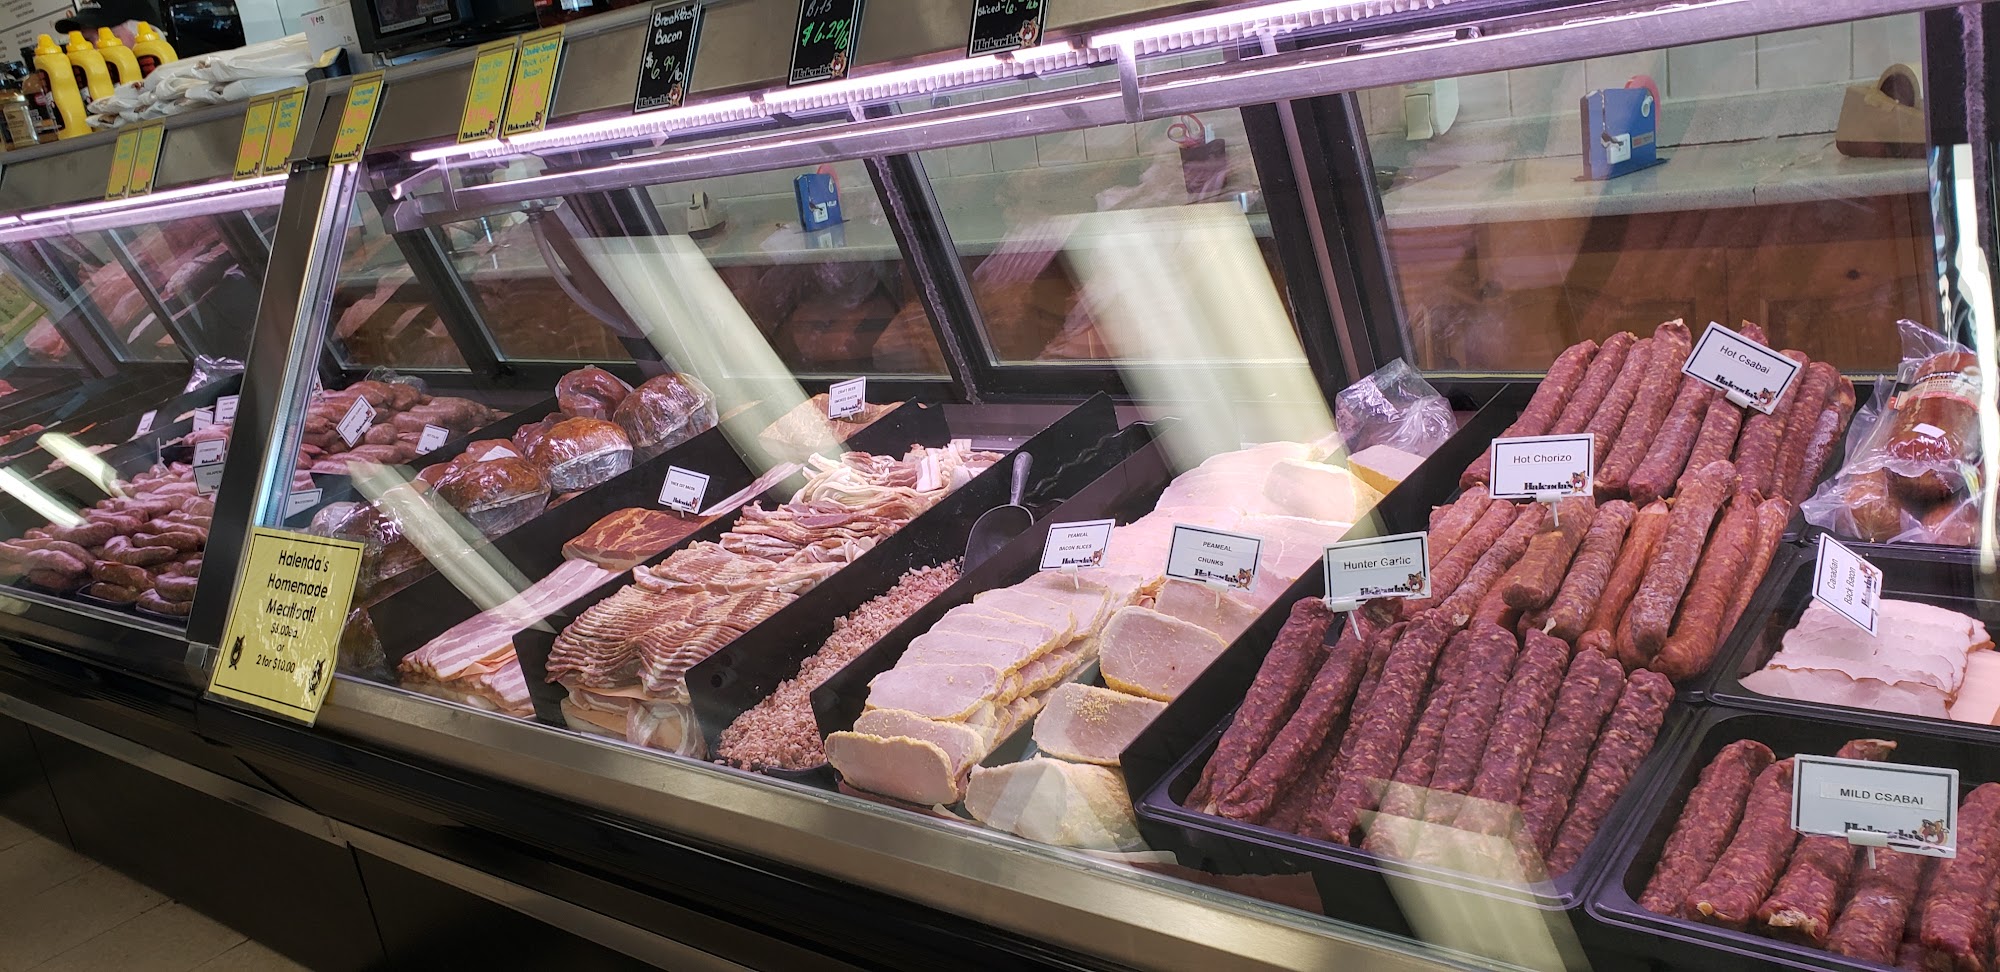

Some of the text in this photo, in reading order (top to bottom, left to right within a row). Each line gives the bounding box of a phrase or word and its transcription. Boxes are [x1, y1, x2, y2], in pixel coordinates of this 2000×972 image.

[654, 5, 698, 27] Breakfast
[655, 28, 682, 45] Bacon
[1719, 345, 1770, 375] Hot Csabai
[1513, 453, 1572, 464] Hot Chorizo
[1524, 481, 1573, 491] Halenda's
[1202, 541, 1232, 552] PEAMEAL
[278, 549, 330, 573] Halenda's
[1197, 556, 1224, 566] CHUNKS
[1343, 557, 1411, 570] Hunter Garlic
[1827, 558, 1838, 590] Canadian
[266, 573, 328, 599] Homemade
[1844, 567, 1855, 605] Back Bacon
[265, 598, 317, 623] Meatloaf!
[276, 643, 285, 652] or
[256, 653, 296, 674] 2 for $10.00
[1840, 788, 1924, 805] MILD CSABAI
